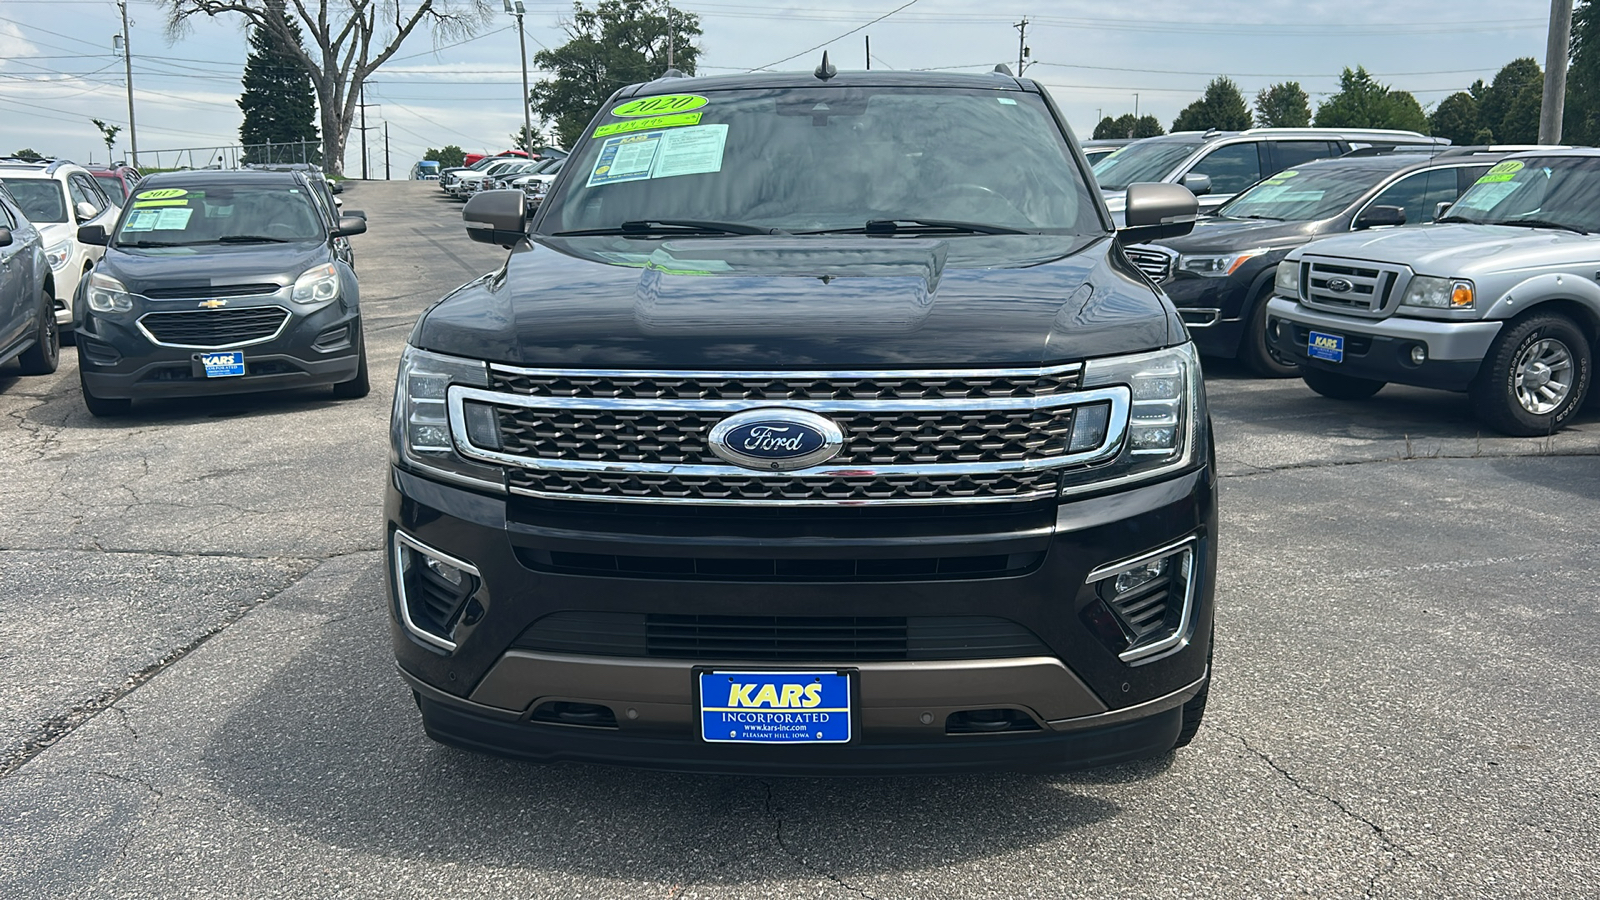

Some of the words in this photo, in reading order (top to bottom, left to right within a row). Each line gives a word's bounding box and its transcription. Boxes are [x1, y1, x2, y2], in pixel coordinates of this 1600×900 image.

[624, 96, 694, 114] 2020
[144, 190, 179, 198] 2017
[1315, 336, 1338, 349] KARS
[202, 356, 234, 365] KARS
[744, 425, 804, 451] Ford
[727, 683, 822, 708] KARS
[722, 712, 830, 723] INCORPORATED
